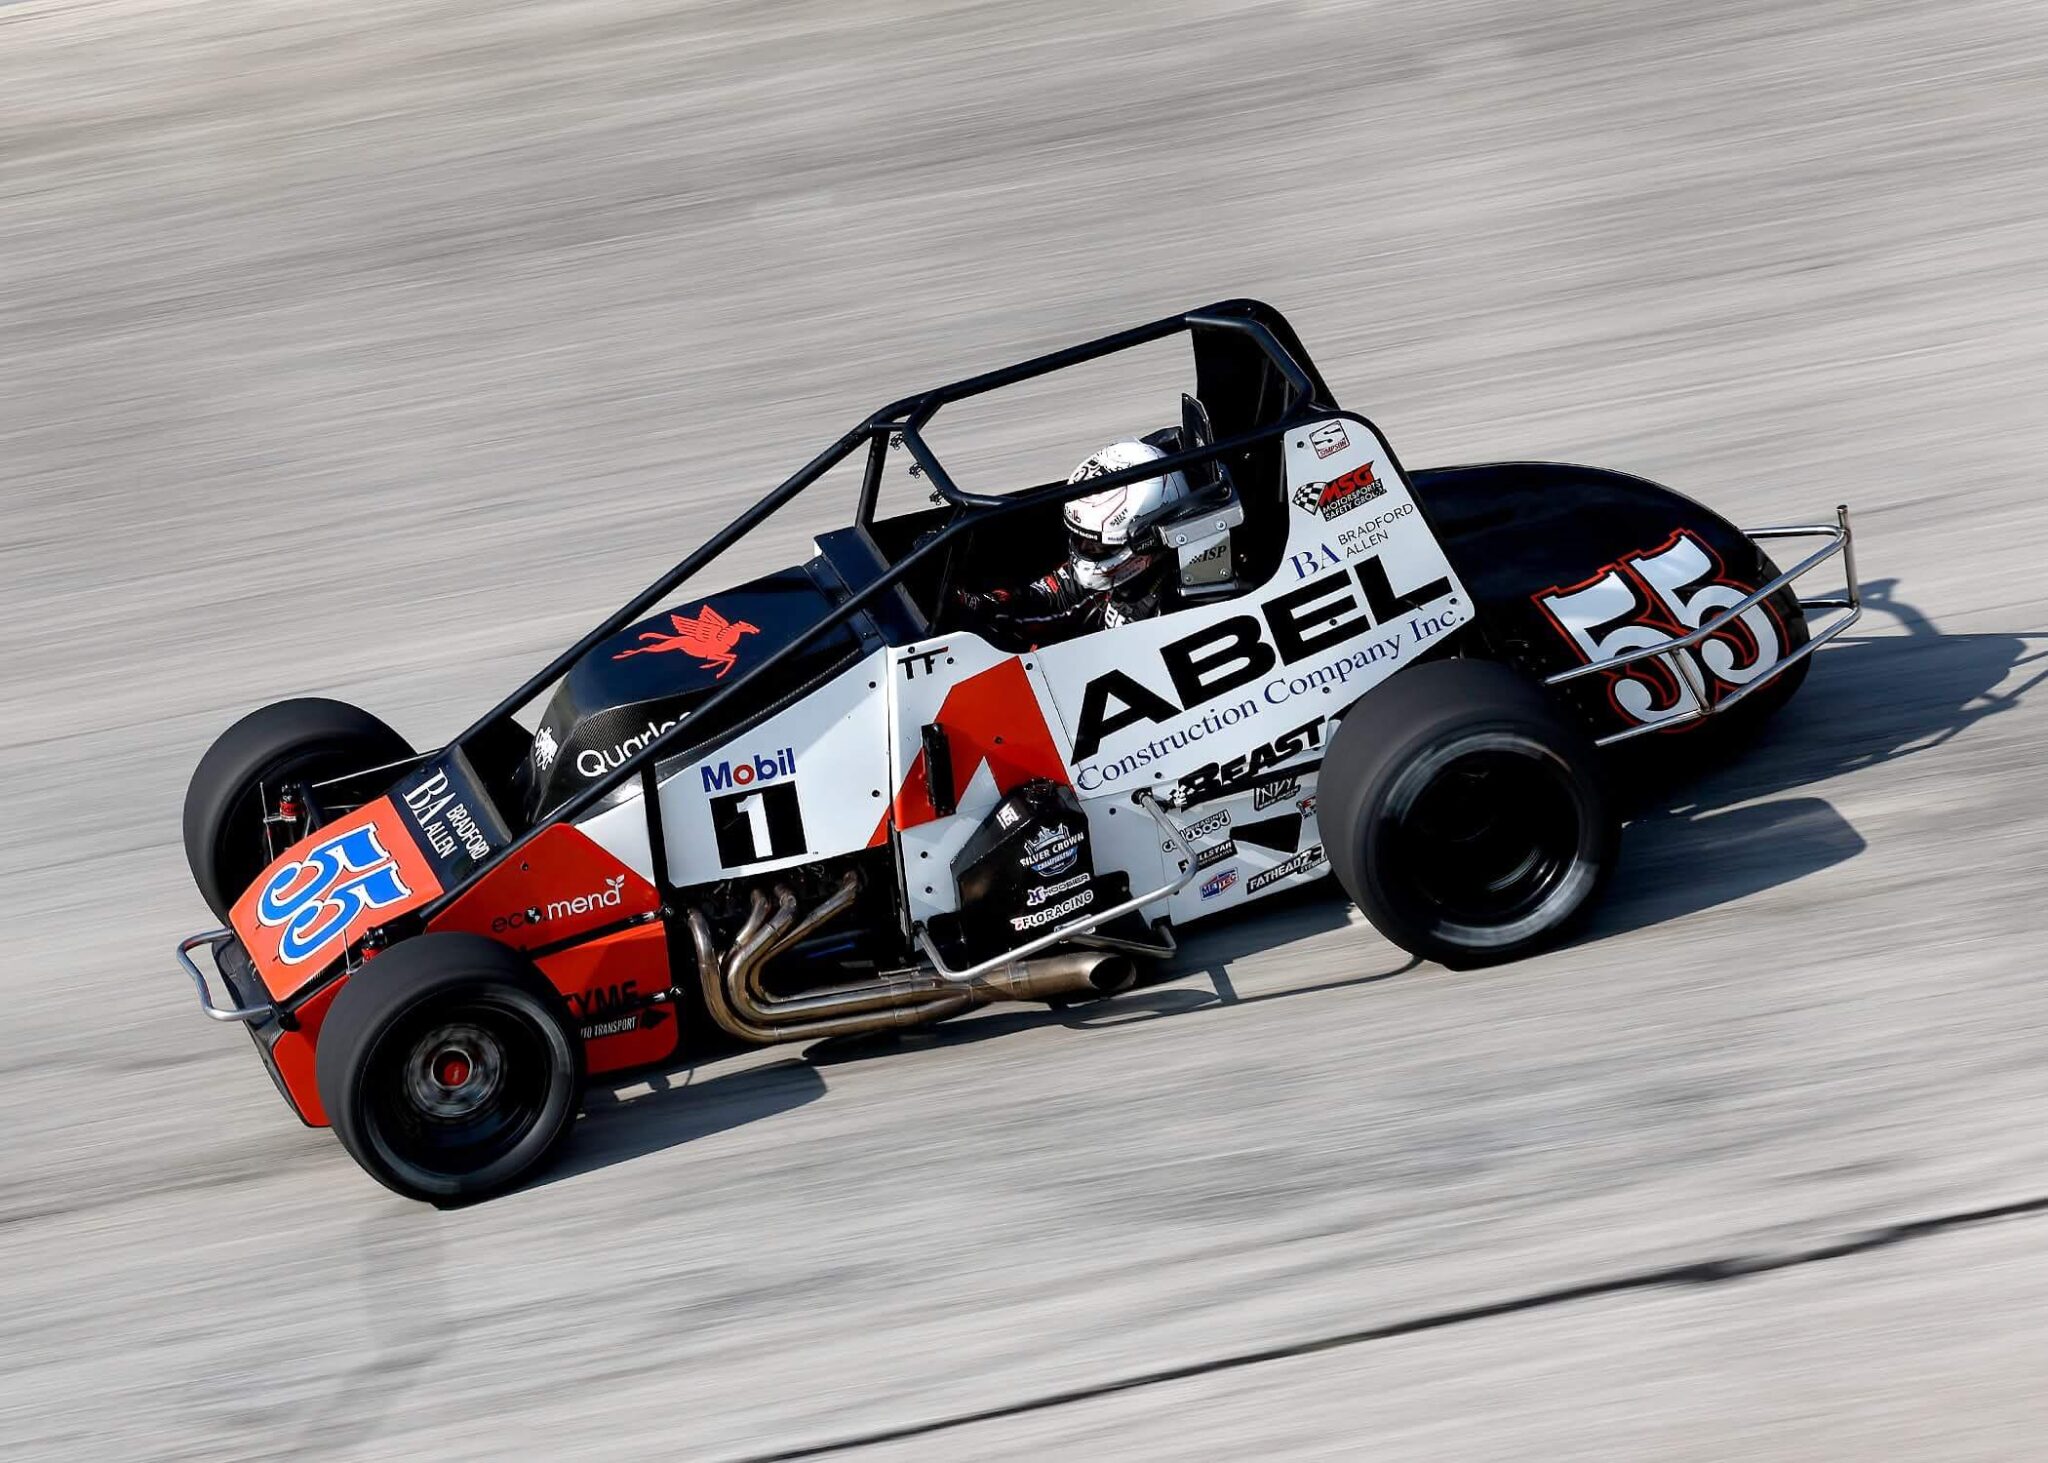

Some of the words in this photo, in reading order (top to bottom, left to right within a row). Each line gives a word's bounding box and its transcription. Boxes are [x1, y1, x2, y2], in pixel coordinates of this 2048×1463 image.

[1319, 463, 1375, 506] MSG
[1322, 480, 1381, 513] MOTORSPORTS
[1325, 496, 1352, 521] SAFETY
[1337, 503, 1414, 546] BRADFORD
[1201, 545, 1227, 563] ISP
[1289, 543, 1341, 581] BA
[1345, 529, 1389, 559] ALLEN
[1537, 532, 1784, 728] 55
[1071, 554, 1454, 766] ABEL
[1076, 699, 1259, 791] Construction
[1264, 633, 1401, 707] Company
[1409, 607, 1466, 643] Inc.
[700, 747, 797, 793] Mobil
[1177, 714, 1326, 795] BEAST
[402, 767, 457, 829] BA
[423, 821, 458, 859] ALLEN
[446, 803, 491, 861] BRADFORD
[736, 792, 773, 859] 1
[1019, 848, 1051, 867] SILVER
[1052, 831, 1085, 854] CROWN
[1198, 840, 1233, 861] LLSTAR
[1249, 848, 1313, 890] FATHEADZ
[256, 822, 413, 965] 55
[1021, 889, 1094, 929] FLORACING
[594, 1015, 637, 1037] TRANSPORT
